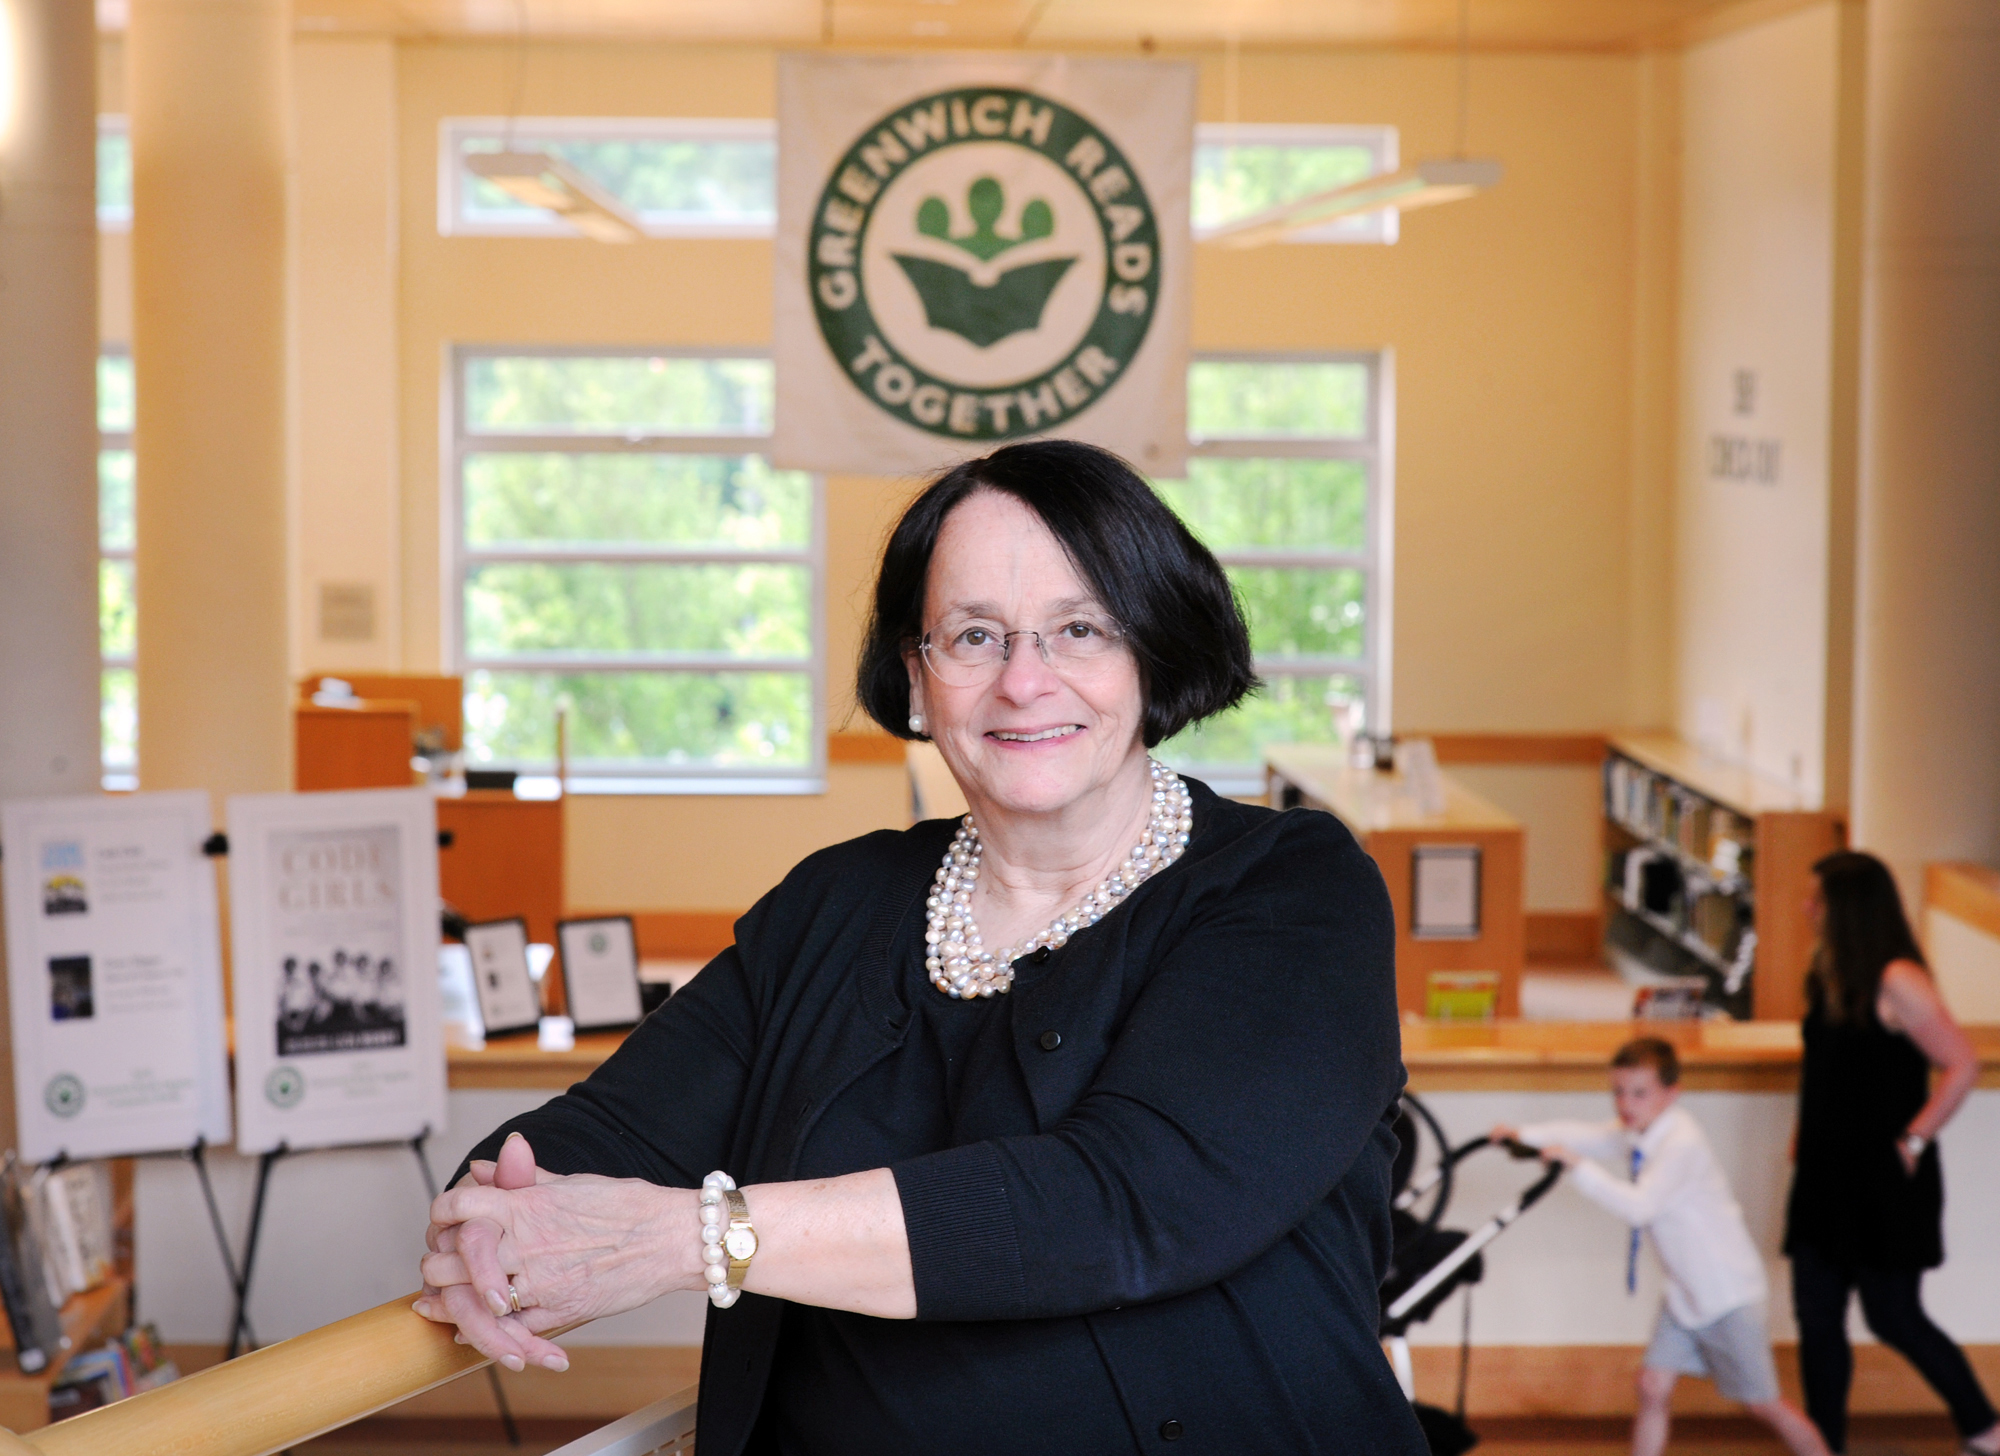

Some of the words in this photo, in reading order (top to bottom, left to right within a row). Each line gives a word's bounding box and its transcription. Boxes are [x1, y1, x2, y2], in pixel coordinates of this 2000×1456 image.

[817, 96, 1055, 311] GREENWICH
[1066, 134, 1153, 317] READS
[852, 335, 1119, 433] TOGETHER
